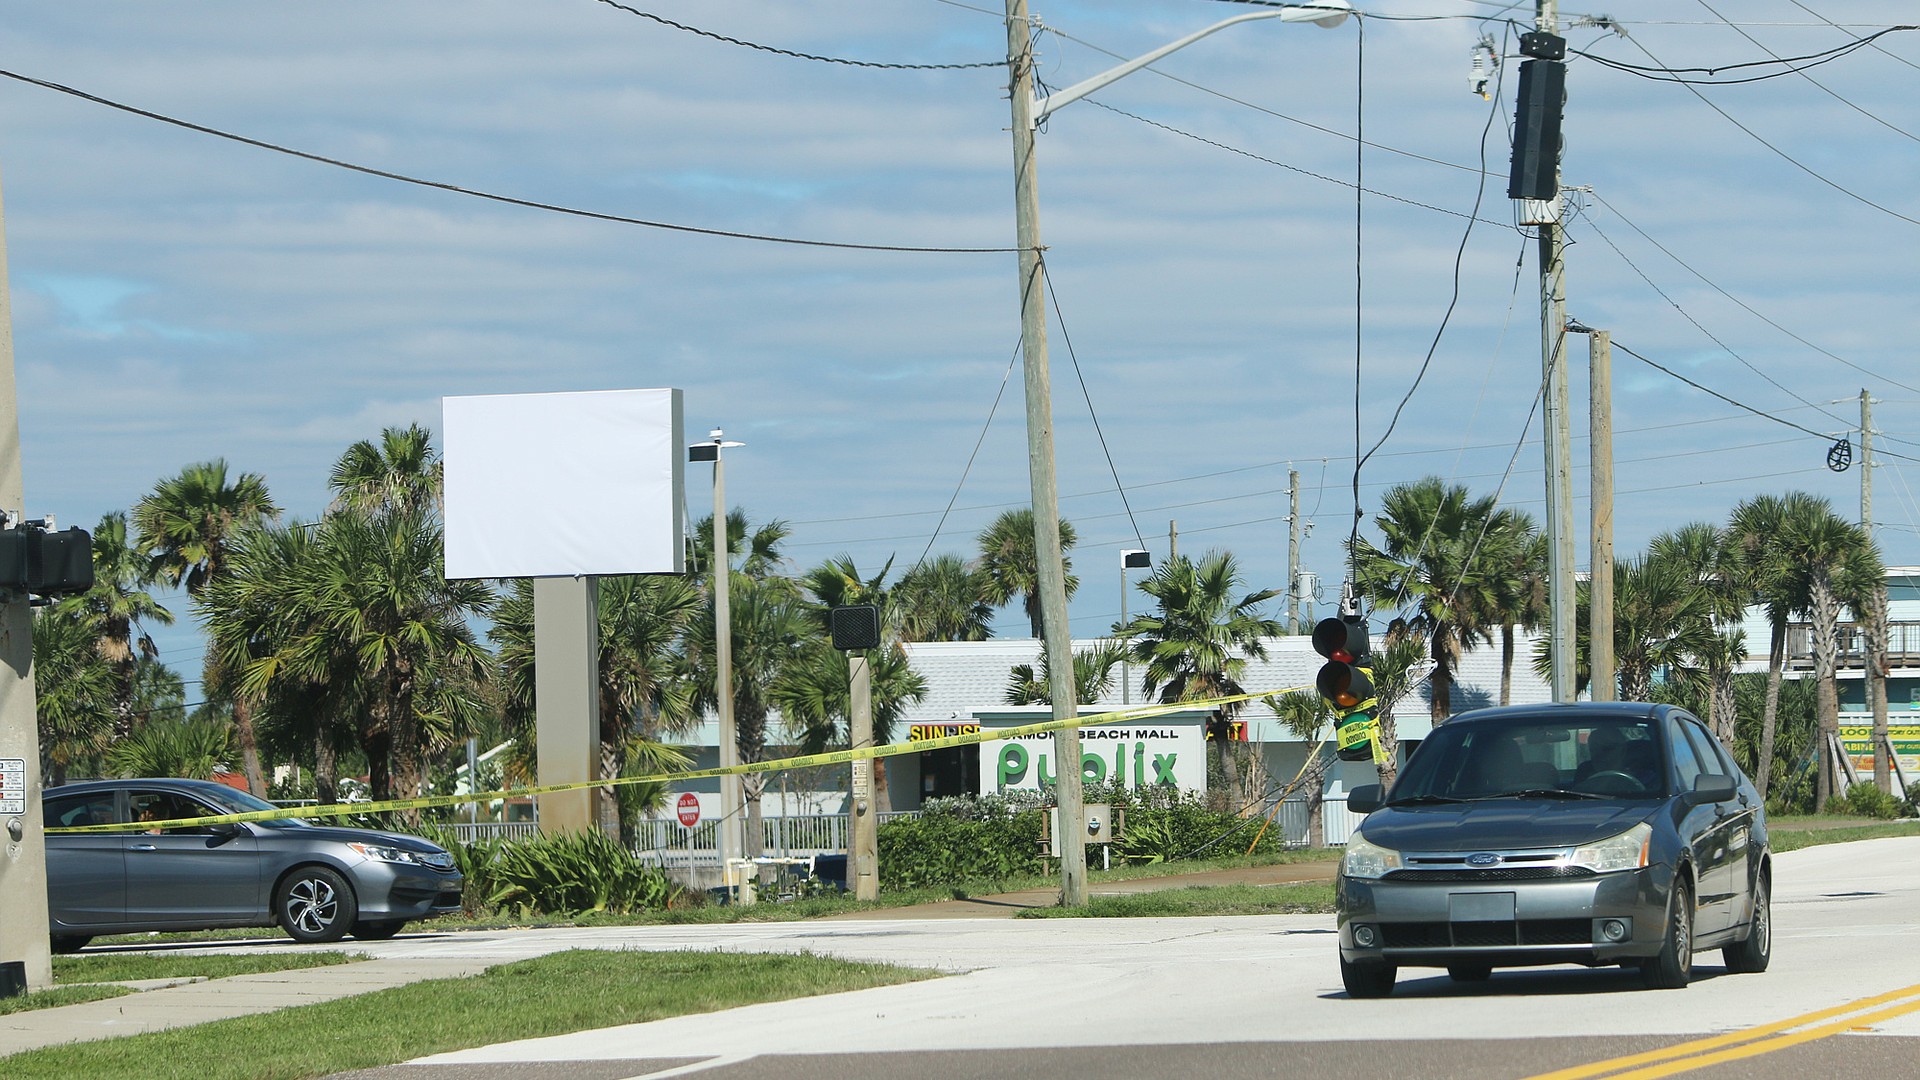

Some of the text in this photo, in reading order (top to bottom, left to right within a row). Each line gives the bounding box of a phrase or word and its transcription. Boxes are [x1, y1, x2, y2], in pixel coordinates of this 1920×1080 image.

[1078, 730, 1130, 739] BEACH
[1136, 730, 1178, 739] MALL
[998, 742, 1178, 785] Publix
